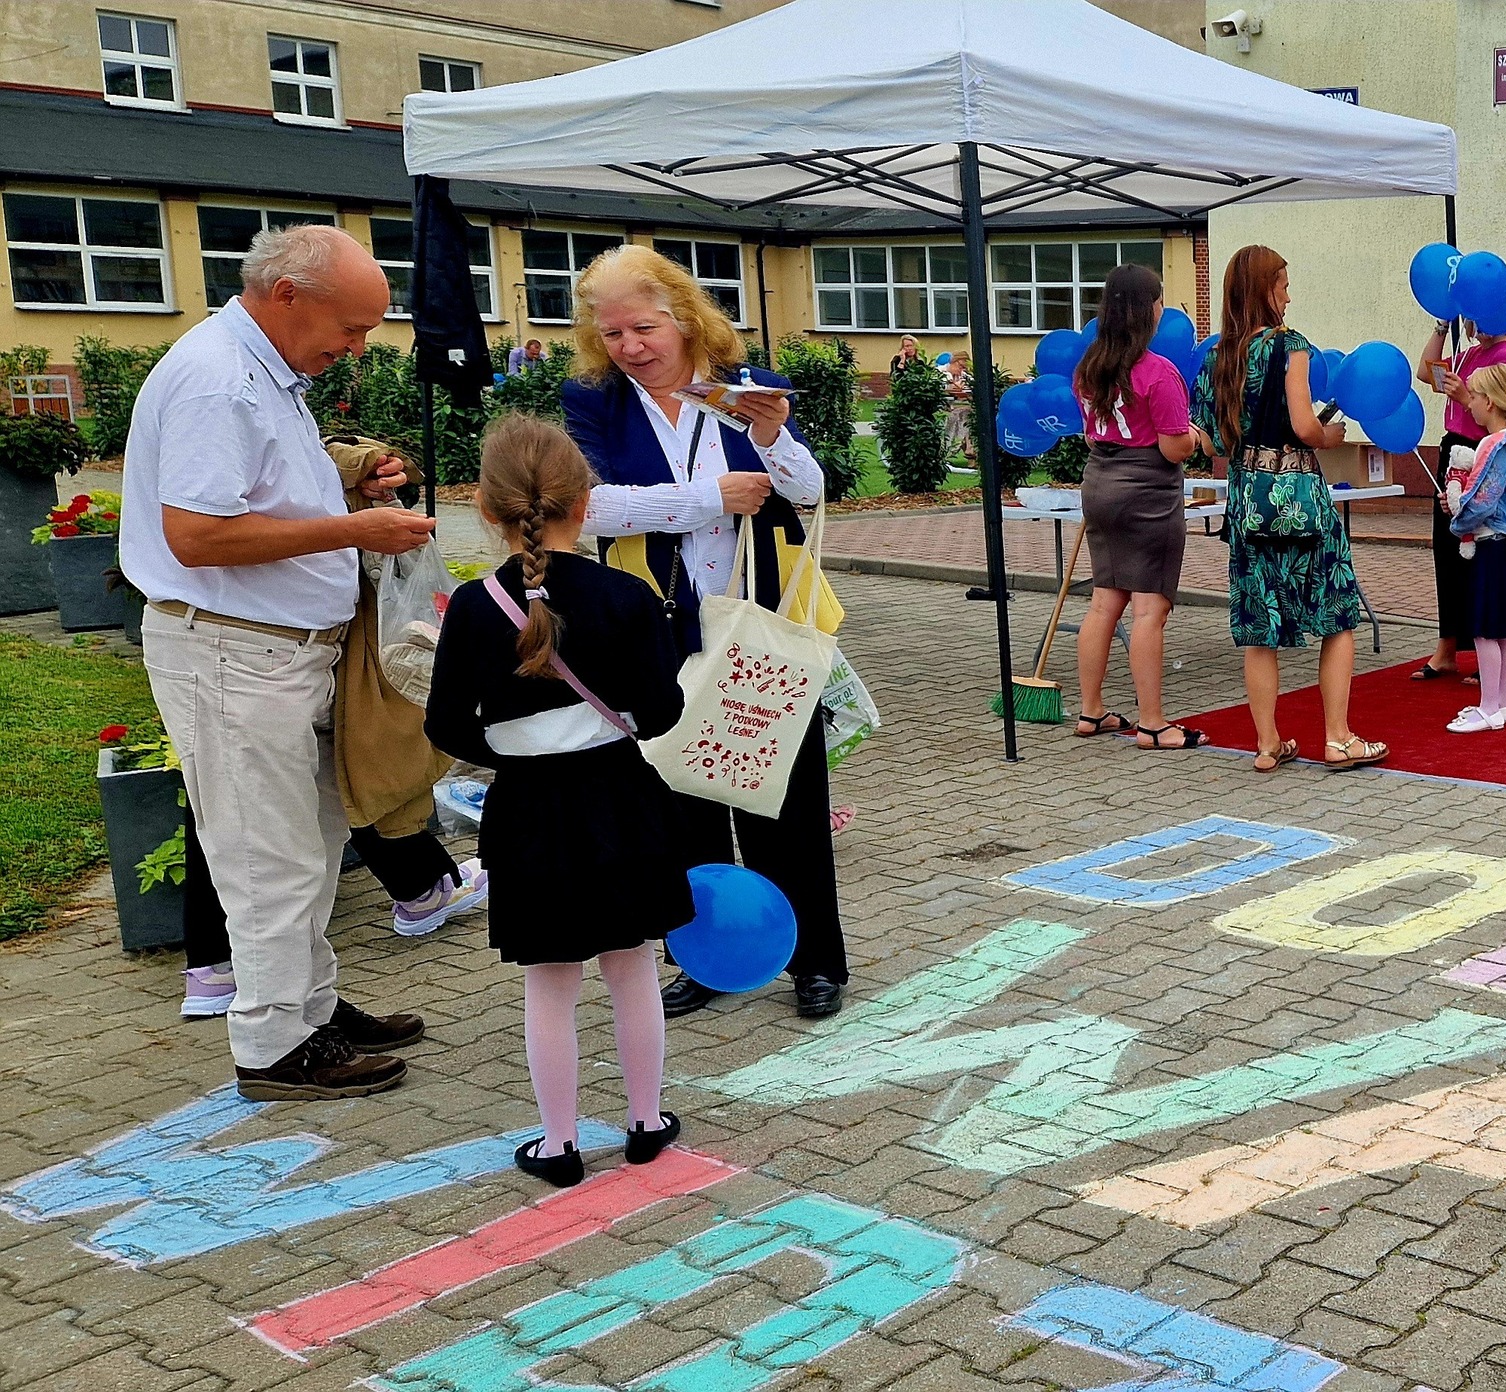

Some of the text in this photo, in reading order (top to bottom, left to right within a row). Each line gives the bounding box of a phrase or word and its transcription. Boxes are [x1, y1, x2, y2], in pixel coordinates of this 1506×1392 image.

[720, 698, 782, 720] NIOSĘ UŚMIECH
[724, 712, 771, 730] Z PODKOWY
[728, 724, 760, 738] LEŚNEJ
